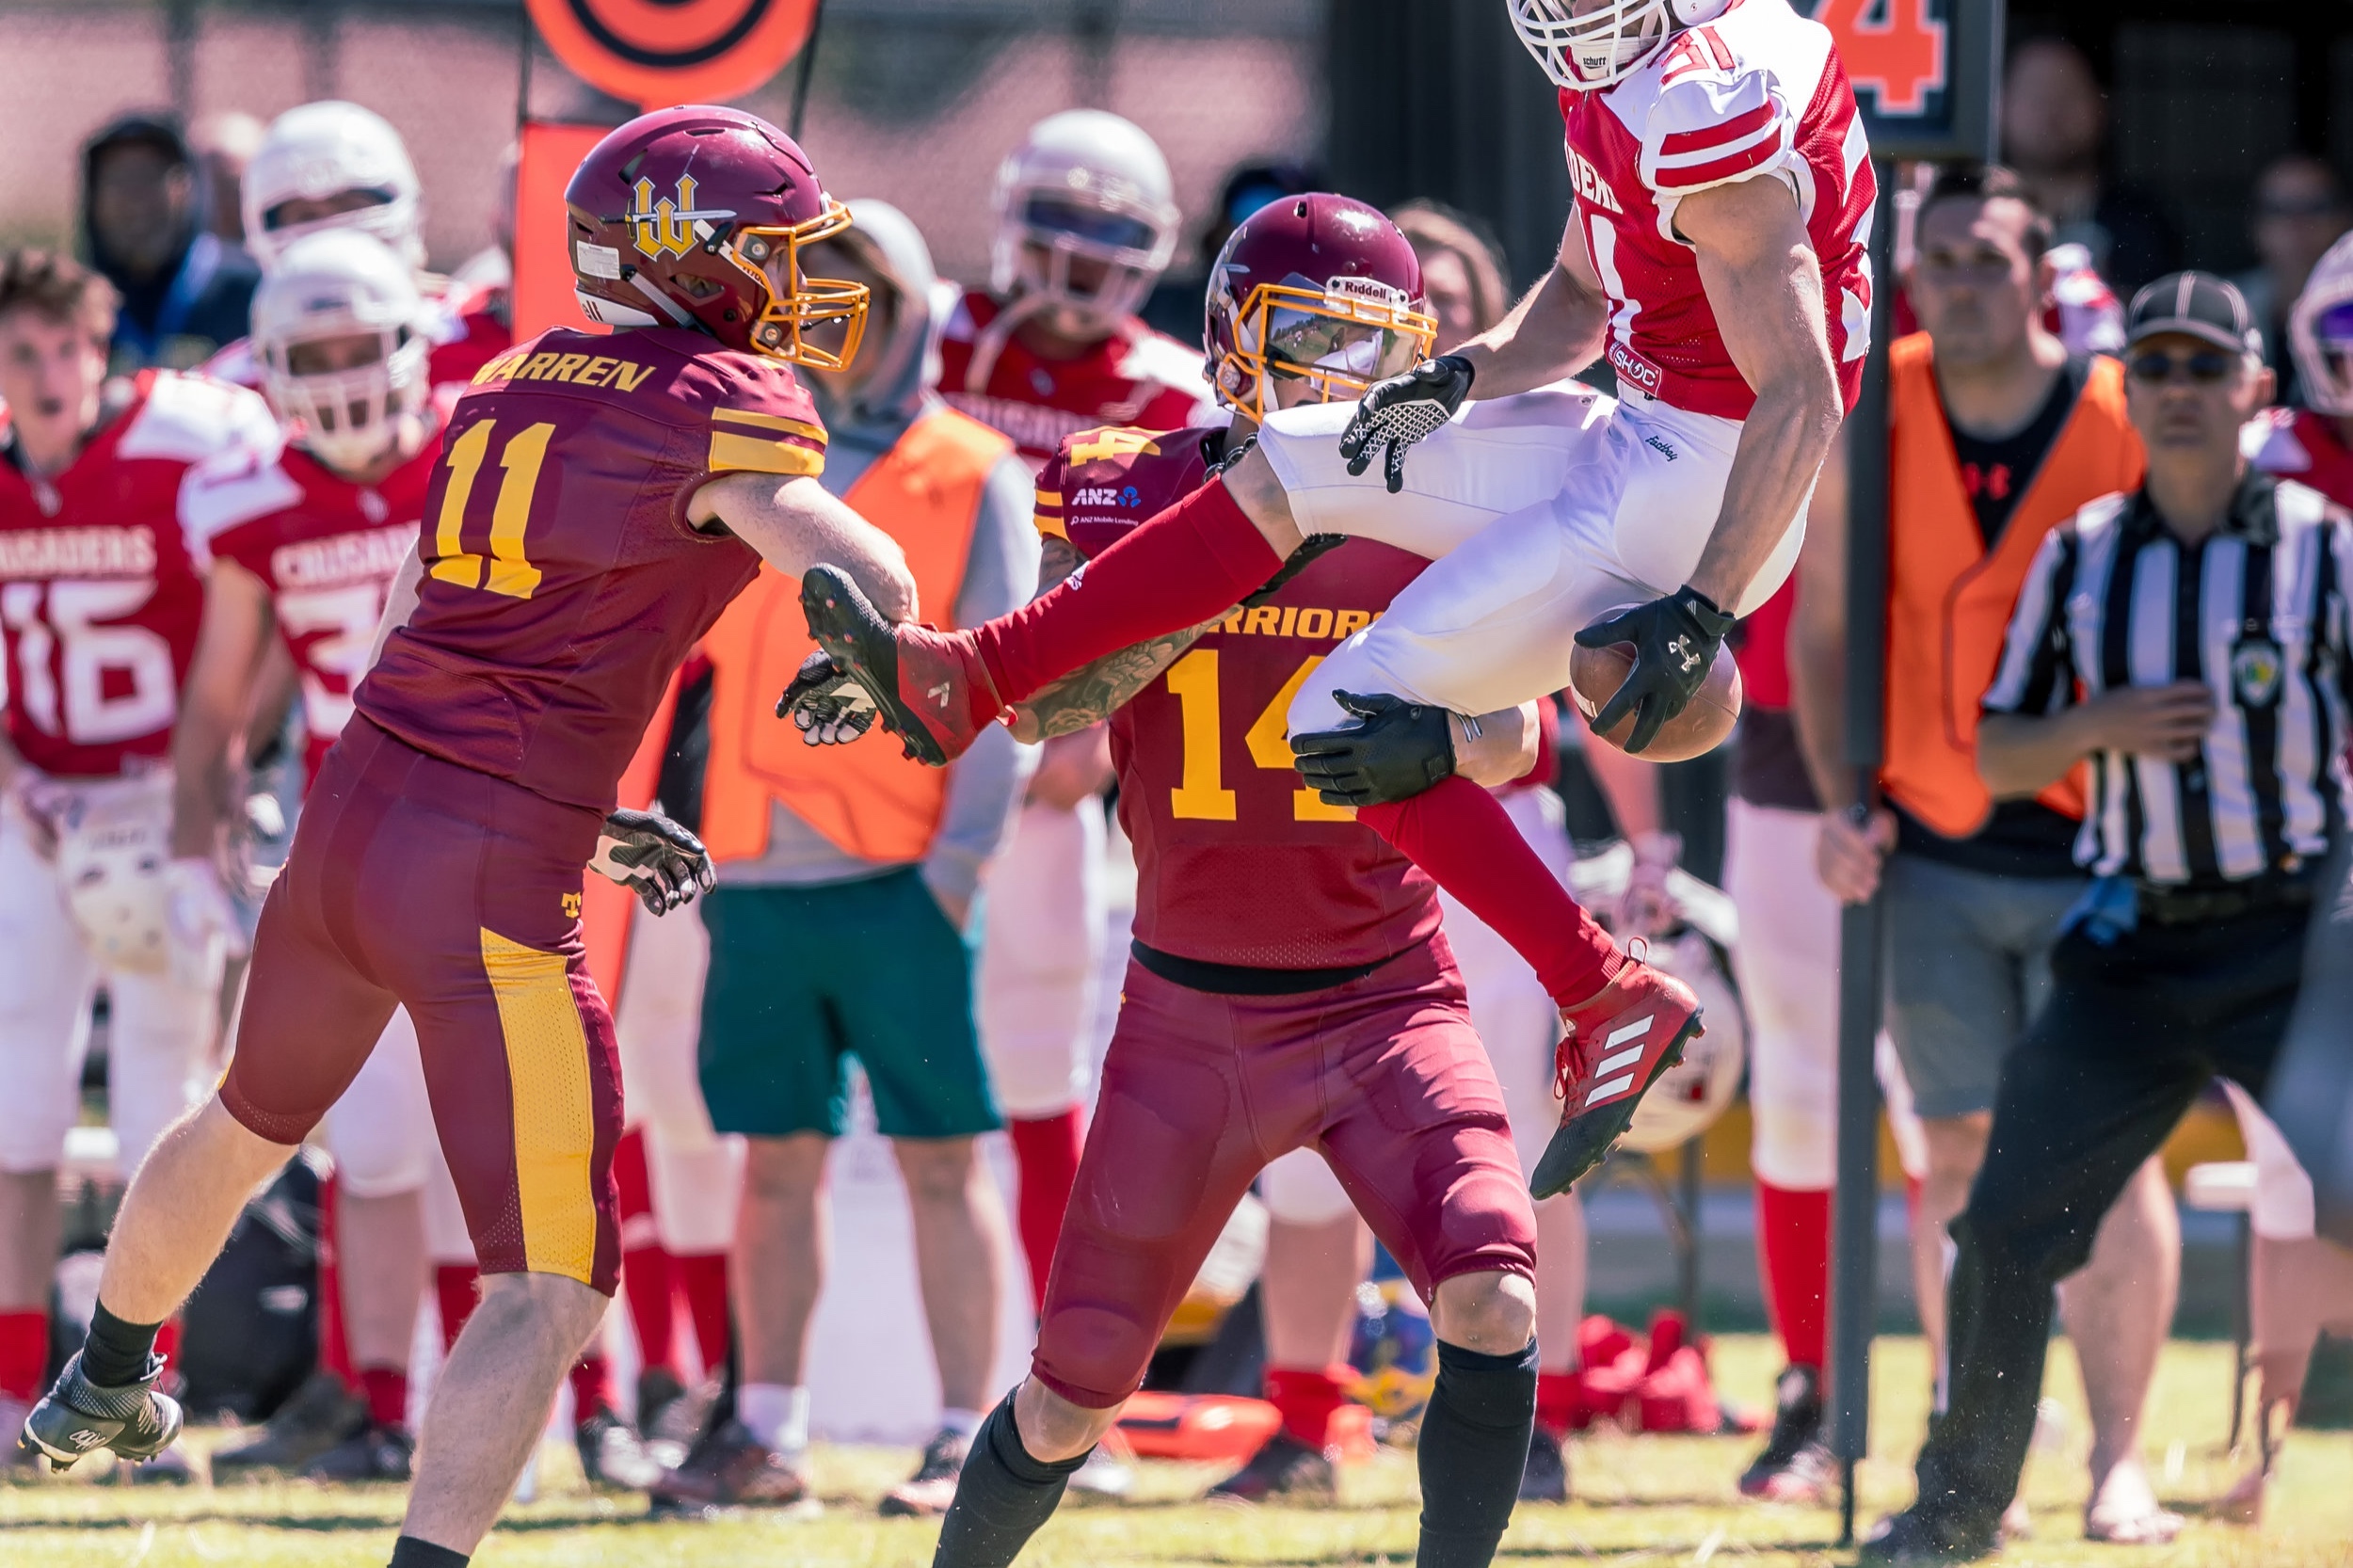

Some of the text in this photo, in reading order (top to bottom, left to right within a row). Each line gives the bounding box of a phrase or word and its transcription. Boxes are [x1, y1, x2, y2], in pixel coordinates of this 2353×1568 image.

[1583, 56, 1607, 66] schutt
[1345, 281, 1386, 299] Riddell
[470, 352, 657, 392] WARREN
[1645, 435, 1678, 462] Eastbay
[430, 418, 556, 600] 11
[1071, 488, 1118, 505] ANZ
[1114, 517, 1139, 527] Lending
[1208, 606, 1385, 639] RRIOR
[1167, 649, 1357, 822] 14
